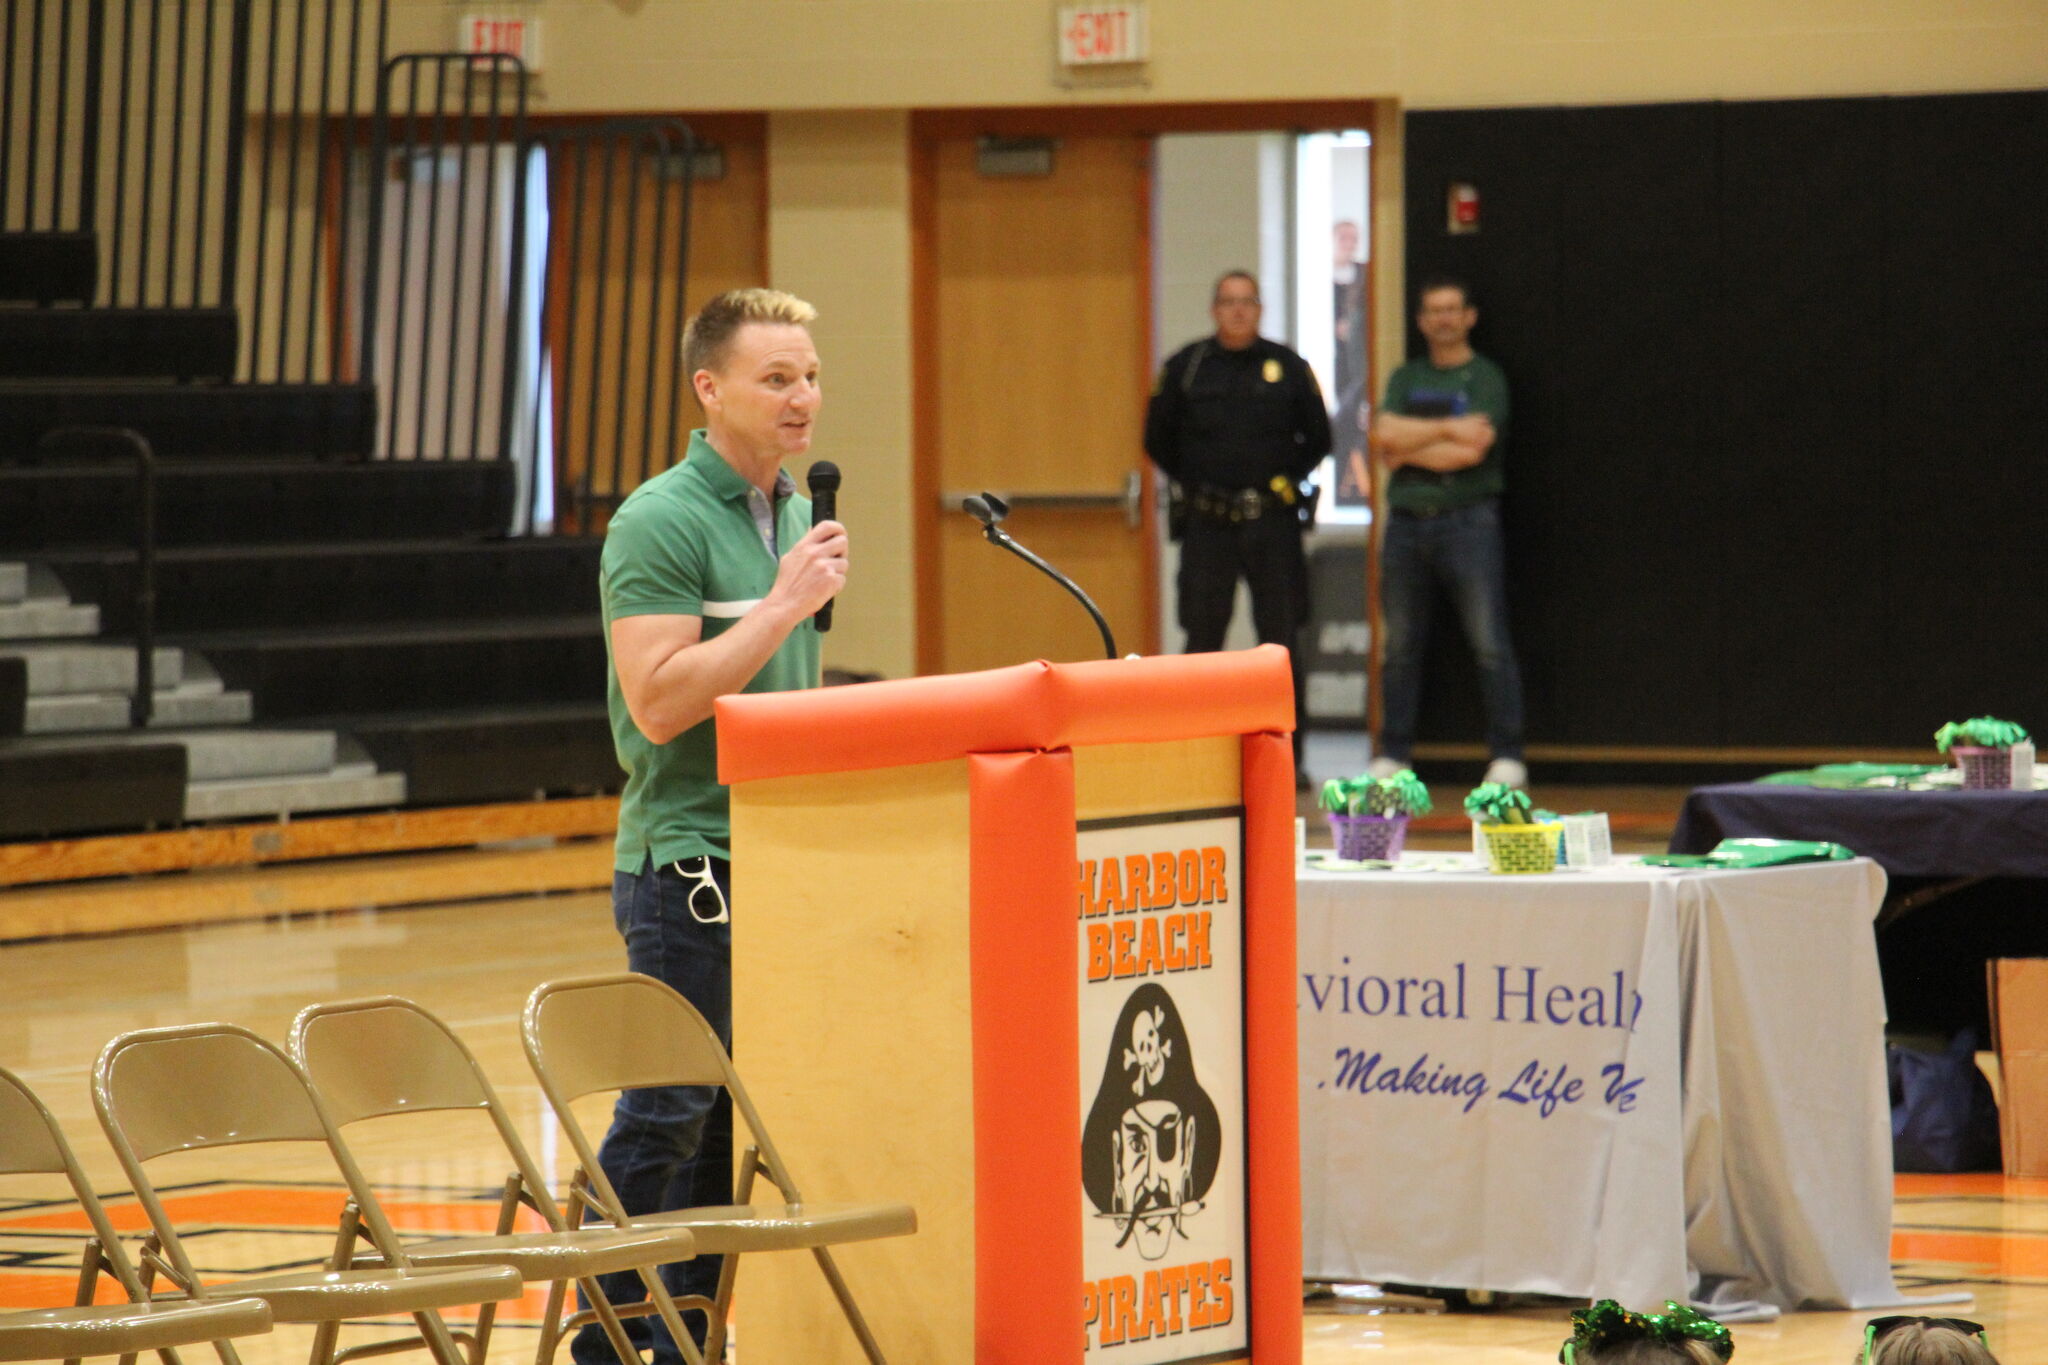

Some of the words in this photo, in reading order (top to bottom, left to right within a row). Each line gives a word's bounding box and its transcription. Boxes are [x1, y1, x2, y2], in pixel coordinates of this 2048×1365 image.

[472, 21, 522, 62] EXIT
[1075, 11, 1128, 56] EXIT
[1077, 846, 1228, 919] HARBOR
[1087, 911, 1212, 983] BEACH
[1297, 956, 1468, 1020] vioral
[1492, 963, 1642, 1033] Heal
[1498, 1058, 1585, 1118] Life
[1083, 1257, 1233, 1351] PIRATES
